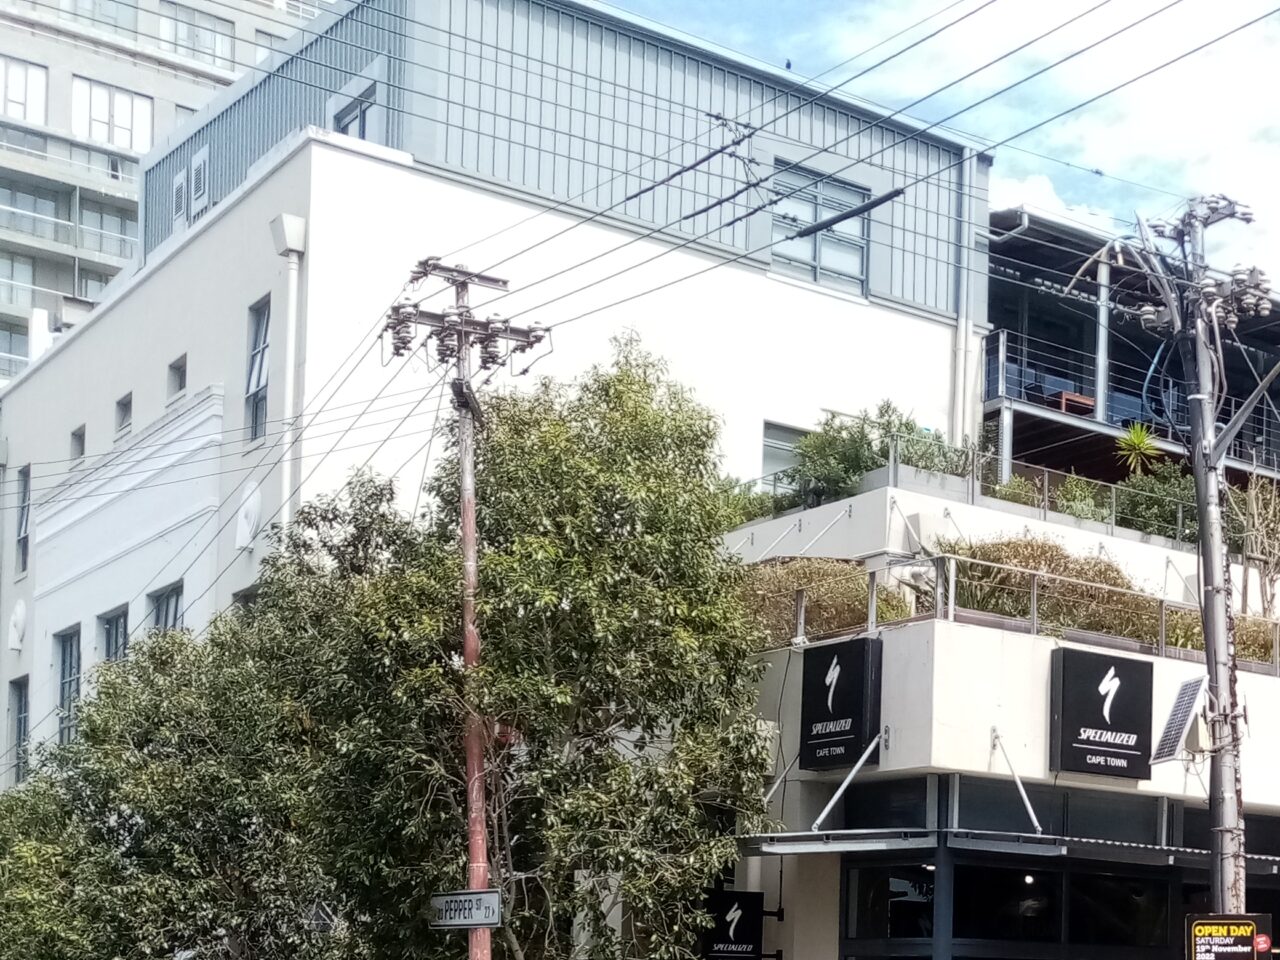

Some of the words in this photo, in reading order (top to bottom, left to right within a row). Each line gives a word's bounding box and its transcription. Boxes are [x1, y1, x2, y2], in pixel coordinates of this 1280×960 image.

[811, 718, 852, 735] SPECIALIZED
[1078, 727, 1138, 746] SPECIALIZED
[816, 747, 829, 757] CAPE
[830, 746, 845, 755] TOWN
[1086, 755, 1106, 765] CAPE
[1106, 757, 1128, 768] TOWN
[445, 899, 473, 920] PEPPER
[1195, 925, 1227, 937] OPEN
[1229, 925, 1253, 937] DAY
[1196, 937, 1235, 945] SATURDAY
